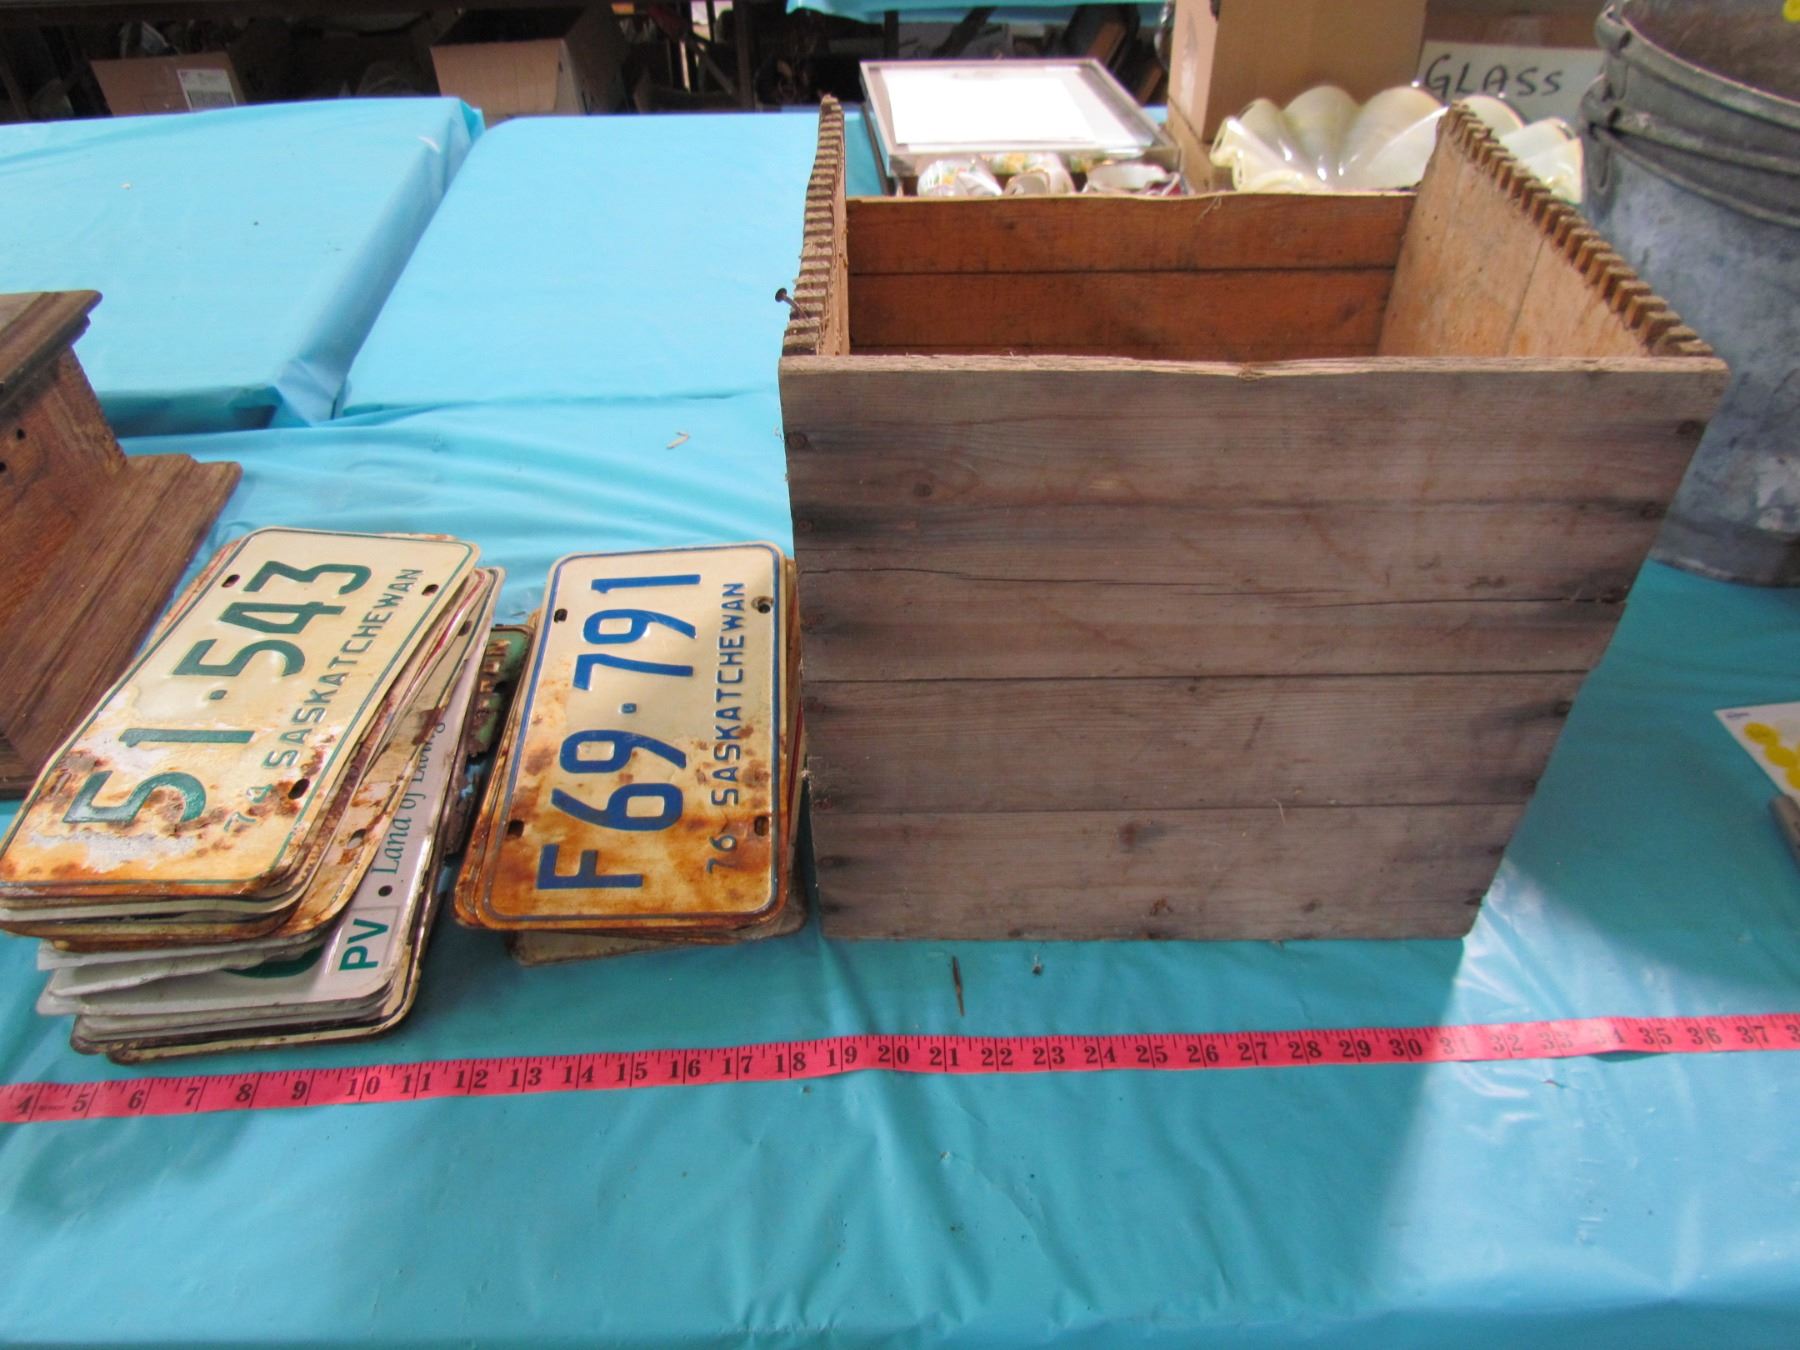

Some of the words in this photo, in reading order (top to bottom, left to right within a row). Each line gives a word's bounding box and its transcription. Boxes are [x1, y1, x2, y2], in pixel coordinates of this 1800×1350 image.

[1425, 54, 1563, 99] GLASS
[263, 568, 424, 770] SASKATCHEWAN
[711, 582, 746, 807] SASKATCHEWAN
[707, 834, 737, 874] 76
[338, 918, 390, 972] PV
[15, 1095, 33, 1114] 4
[71, 1094, 89, 1112] 5
[128, 1090, 144, 1109] 6
[185, 1087, 199, 1106] 7
[235, 1083, 251, 1102] 8
[291, 1080, 307, 1100] 9
[347, 1076, 380, 1096] 10
[401, 1072, 431, 1093] 11
[455, 1069, 488, 1088] 12
[510, 1067, 541, 1087] 13
[563, 1065, 594, 1084] 14
[615, 1062, 648, 1082] 15
[669, 1058, 701, 1079] 16
[722, 1055, 753, 1075] 17
[775, 1052, 806, 1073] 18
[827, 1045, 857, 1067] 19
[878, 1045, 910, 1064] 20
[929, 1046, 959, 1066] 21
[981, 1047, 1013, 1066] 22
[1033, 1046, 1065, 1065] 23
[1085, 1045, 1116, 1063] 24
[1136, 1045, 1168, 1063] 25
[1188, 1045, 1219, 1063] 26
[1237, 1042, 1268, 1061] 27
[1289, 1041, 1322, 1059] 28
[1339, 1039, 1372, 1057] 29
[1389, 1038, 1423, 1057] 30
[1440, 1036, 1471, 1055] 31
[1489, 1033, 1523, 1052] 32
[1638, 1026, 1673, 1045] 35
[1687, 1026, 1723, 1045] 36
[1736, 1025, 1769, 1044] 37
